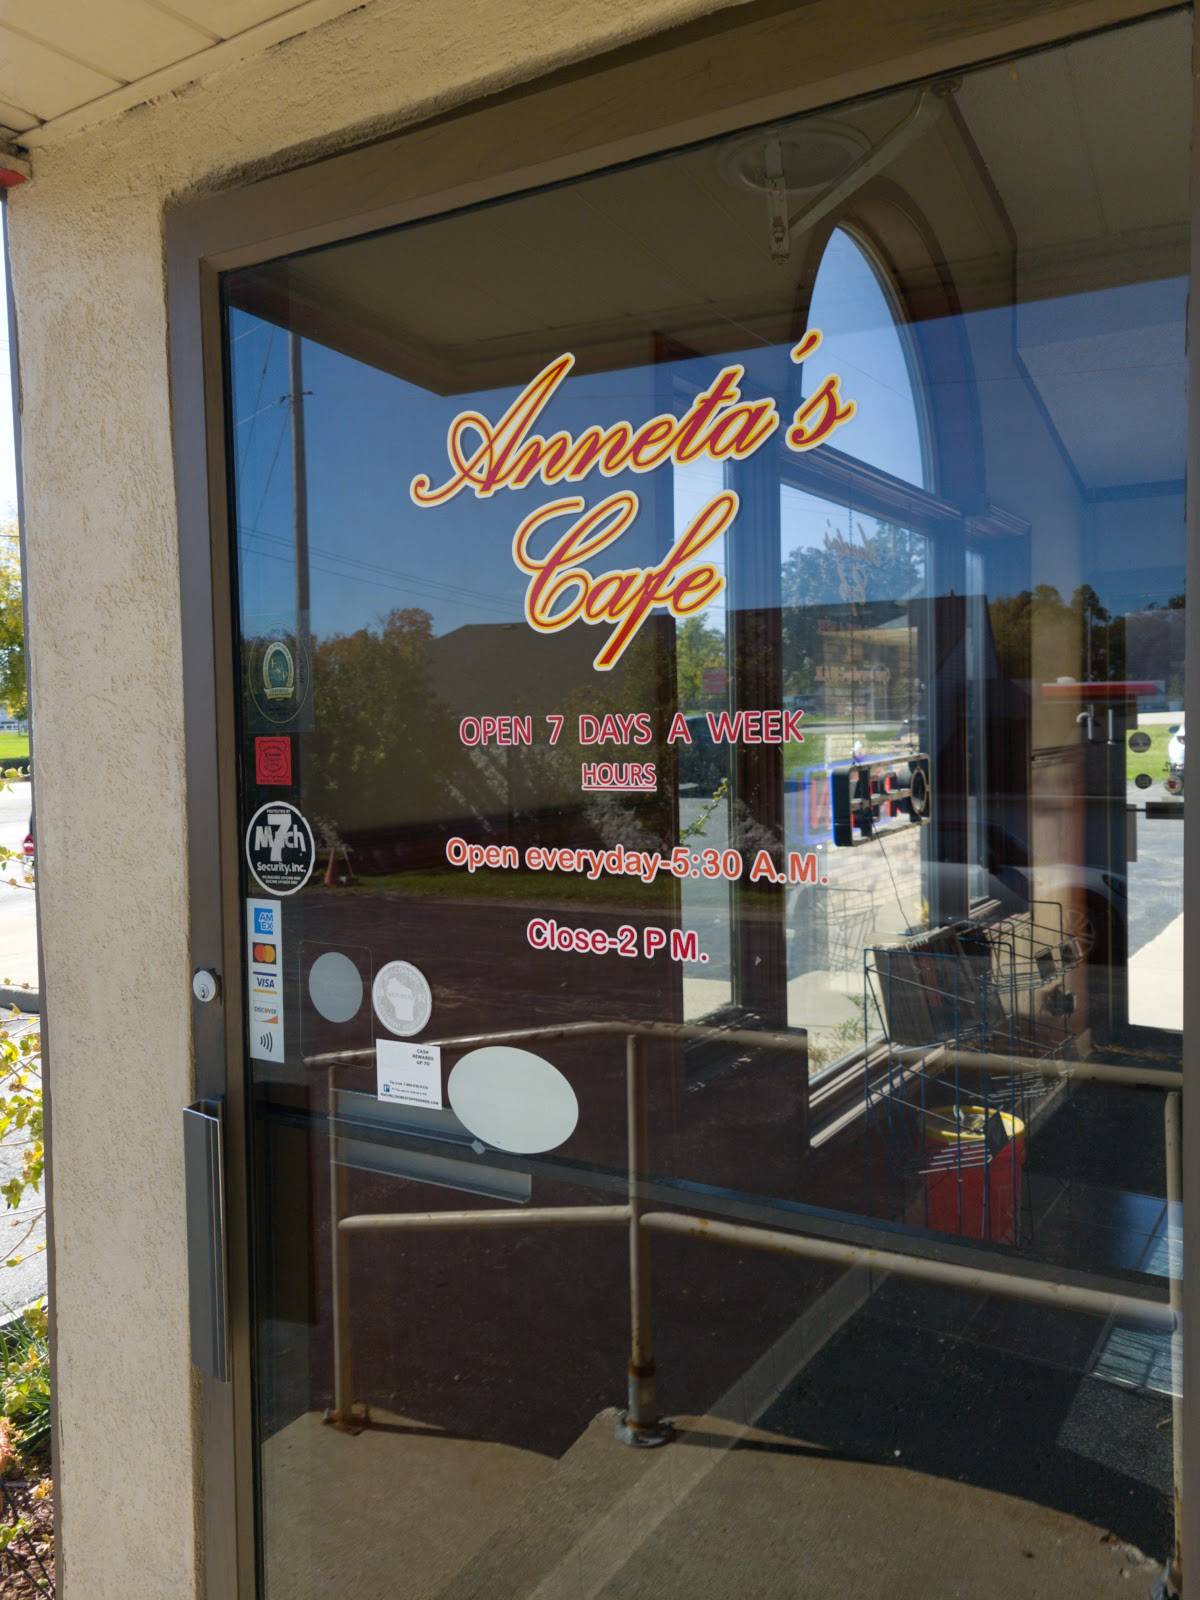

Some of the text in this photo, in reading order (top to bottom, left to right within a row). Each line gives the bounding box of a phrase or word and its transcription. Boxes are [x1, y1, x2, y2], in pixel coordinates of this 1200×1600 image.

[410, 329, 856, 507] Anneta's
[512, 490, 739, 671] Cafe
[459, 709, 805, 746] OPEN 7 DAYS A WEEK
[581, 762, 657, 787] HOURS
[446, 837, 829, 885] Open everyday-5:30 A.M.
[527, 918, 637, 957] Close-2
[256, 977, 275, 988] VISA
